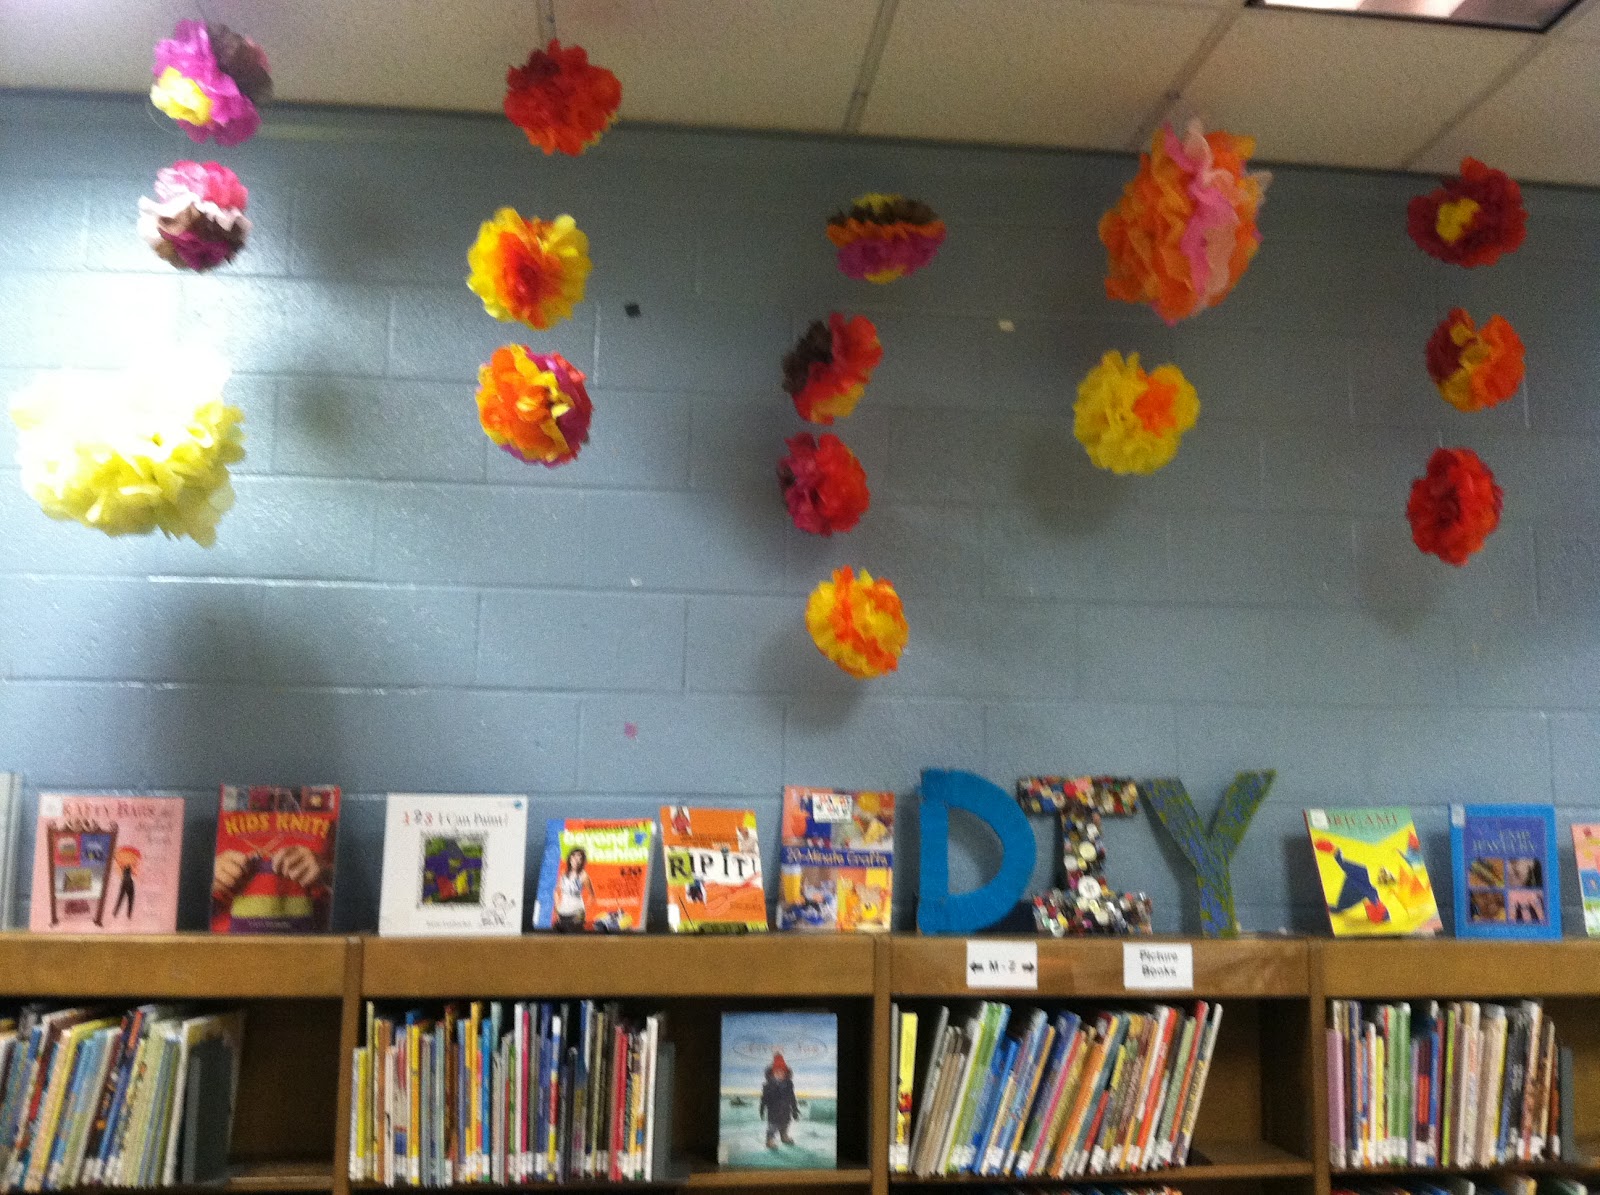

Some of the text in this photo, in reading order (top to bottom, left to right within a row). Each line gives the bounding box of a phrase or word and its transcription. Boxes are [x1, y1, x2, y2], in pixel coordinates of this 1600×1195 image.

[224, 812, 270, 837] KIDS
[917, 768, 1277, 939] DIY
[1139, 949, 1178, 961] Picture
[1141, 965, 1176, 977] Books
